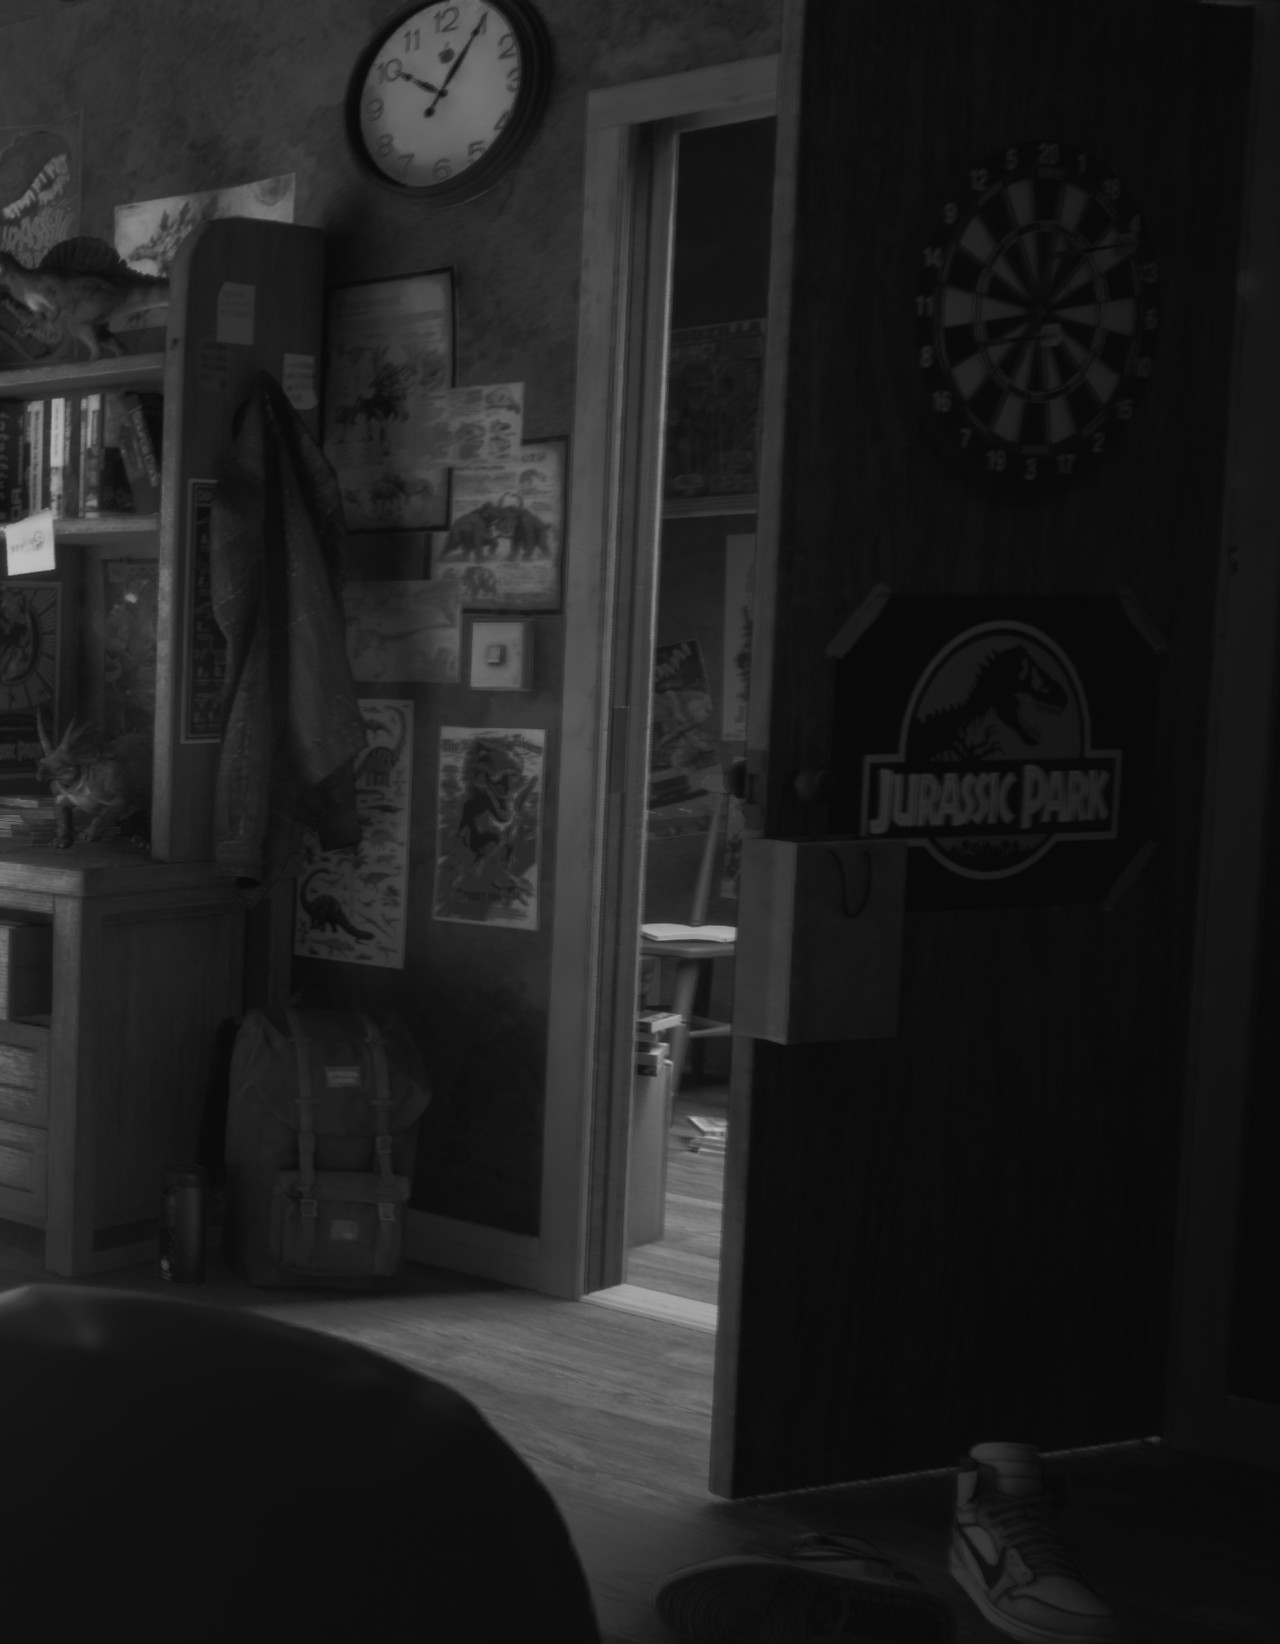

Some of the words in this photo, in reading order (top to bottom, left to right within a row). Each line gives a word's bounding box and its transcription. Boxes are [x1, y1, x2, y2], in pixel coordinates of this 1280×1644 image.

[433, 7, 460, 34] 12
[403, 28, 421, 52] 11
[498, 33, 517, 60] 2
[376, 58, 403, 84] 10
[506, 67, 521, 92] 3
[365, 98, 385, 122] 9
[493, 111, 510, 131] 4
[376, 133, 394, 158] 8
[468, 140, 487, 164] 5
[1037, 143, 1060, 165] 20
[397, 153, 415, 181] 7
[432, 158, 452, 182] 6
[1005, 148, 1019, 170] 5
[1077, 153, 1087, 174] 1
[969, 168, 989, 192] 12
[943, 201, 958, 225] 9
[923, 246, 942, 268] 14
[916, 294, 934, 317] 11
[920, 344, 934, 369] 8
[932, 389, 953, 413] 16
[959, 428, 972, 449] 7
[1091, 432, 1107, 454] 2
[985, 449, 1008, 472] 19
[1023, 457, 1039, 481] 3
[1056, 453, 1077, 475] 17
[870, 767, 1017, 835] JURASSIC
[1019, 763, 1110, 830] PARK
